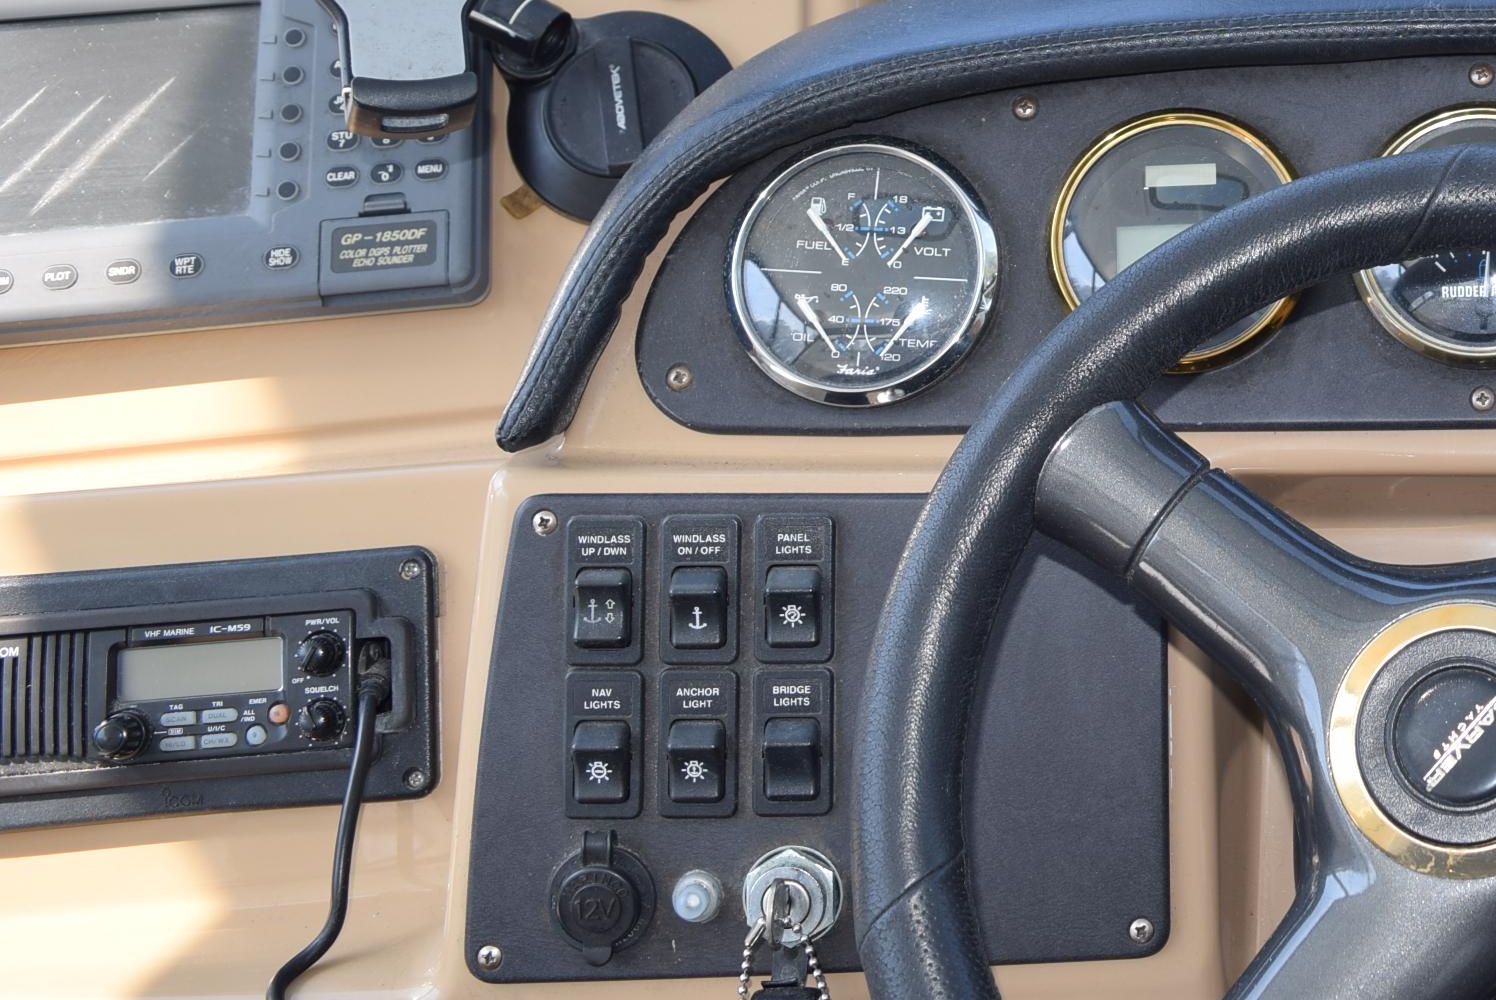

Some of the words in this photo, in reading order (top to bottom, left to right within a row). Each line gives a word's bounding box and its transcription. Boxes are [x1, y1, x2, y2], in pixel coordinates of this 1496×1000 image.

[331, 131, 353, 141] STU
[337, 140, 345, 148] 7
[417, 163, 443, 174] MENU
[326, 170, 356, 182] CLEAR
[847, 192, 856, 200] F
[893, 195, 908, 204] 18
[834, 223, 855, 232] 1/2
[890, 226, 906, 235] 13
[796, 240, 832, 250] FUEL
[269, 247, 292, 258] HIDE
[339, 248, 368, 260] COLOR
[367, 246, 391, 257] DGPS
[391, 243, 429, 255] PLOTTER
[914, 246, 952, 257] VOLT
[174, 256, 196, 266] WPT
[268, 256, 293, 267] SHOW
[351, 257, 376, 268] ECHO
[376, 253, 415, 266] SOUNDER
[841, 258, 849, 266] E
[107, 264, 136, 277] SNDR
[174, 265, 196, 276] RTE
[44, 270, 72, 282] PLOT
[830, 284, 847, 292] 80
[883, 286, 908, 296] 220
[1441, 285, 1489, 299] RUDDER
[828, 316, 845, 324] 40
[880, 317, 901, 327] 175
[792, 332, 816, 342] OIL
[577, 534, 631, 545] WINDLASS
[672, 534, 726, 544] WINDLASS
[776, 533, 811, 543] PANEL
[581, 546, 596, 556] UP
[603, 546, 627, 556] DWN
[677, 546, 693, 556] ON
[700, 545, 722, 555] OFF
[775, 545, 812, 555] LIGHTS
[304, 617, 341, 626] PWR/VOL
[144, 630, 161, 639] VHF
[163, 627, 196, 637] MARINE
[209, 623, 251, 634] IC-M59
[291, 677, 305, 685] OFF
[304, 685, 339, 694] SQUELCH
[591, 687, 612, 697] NAV
[676, 687, 720, 697] ANCHOR
[772, 685, 811, 695] BRIDGE
[248, 697, 268, 705] EMER
[583, 699, 621, 710] LIGHTS
[682, 699, 713, 709] LIGHT
[773, 697, 811, 707] LIGHTS
[168, 703, 184, 711] TAG
[207, 725, 226, 733] U/I/C
[573, 897, 616, 920] 12V
